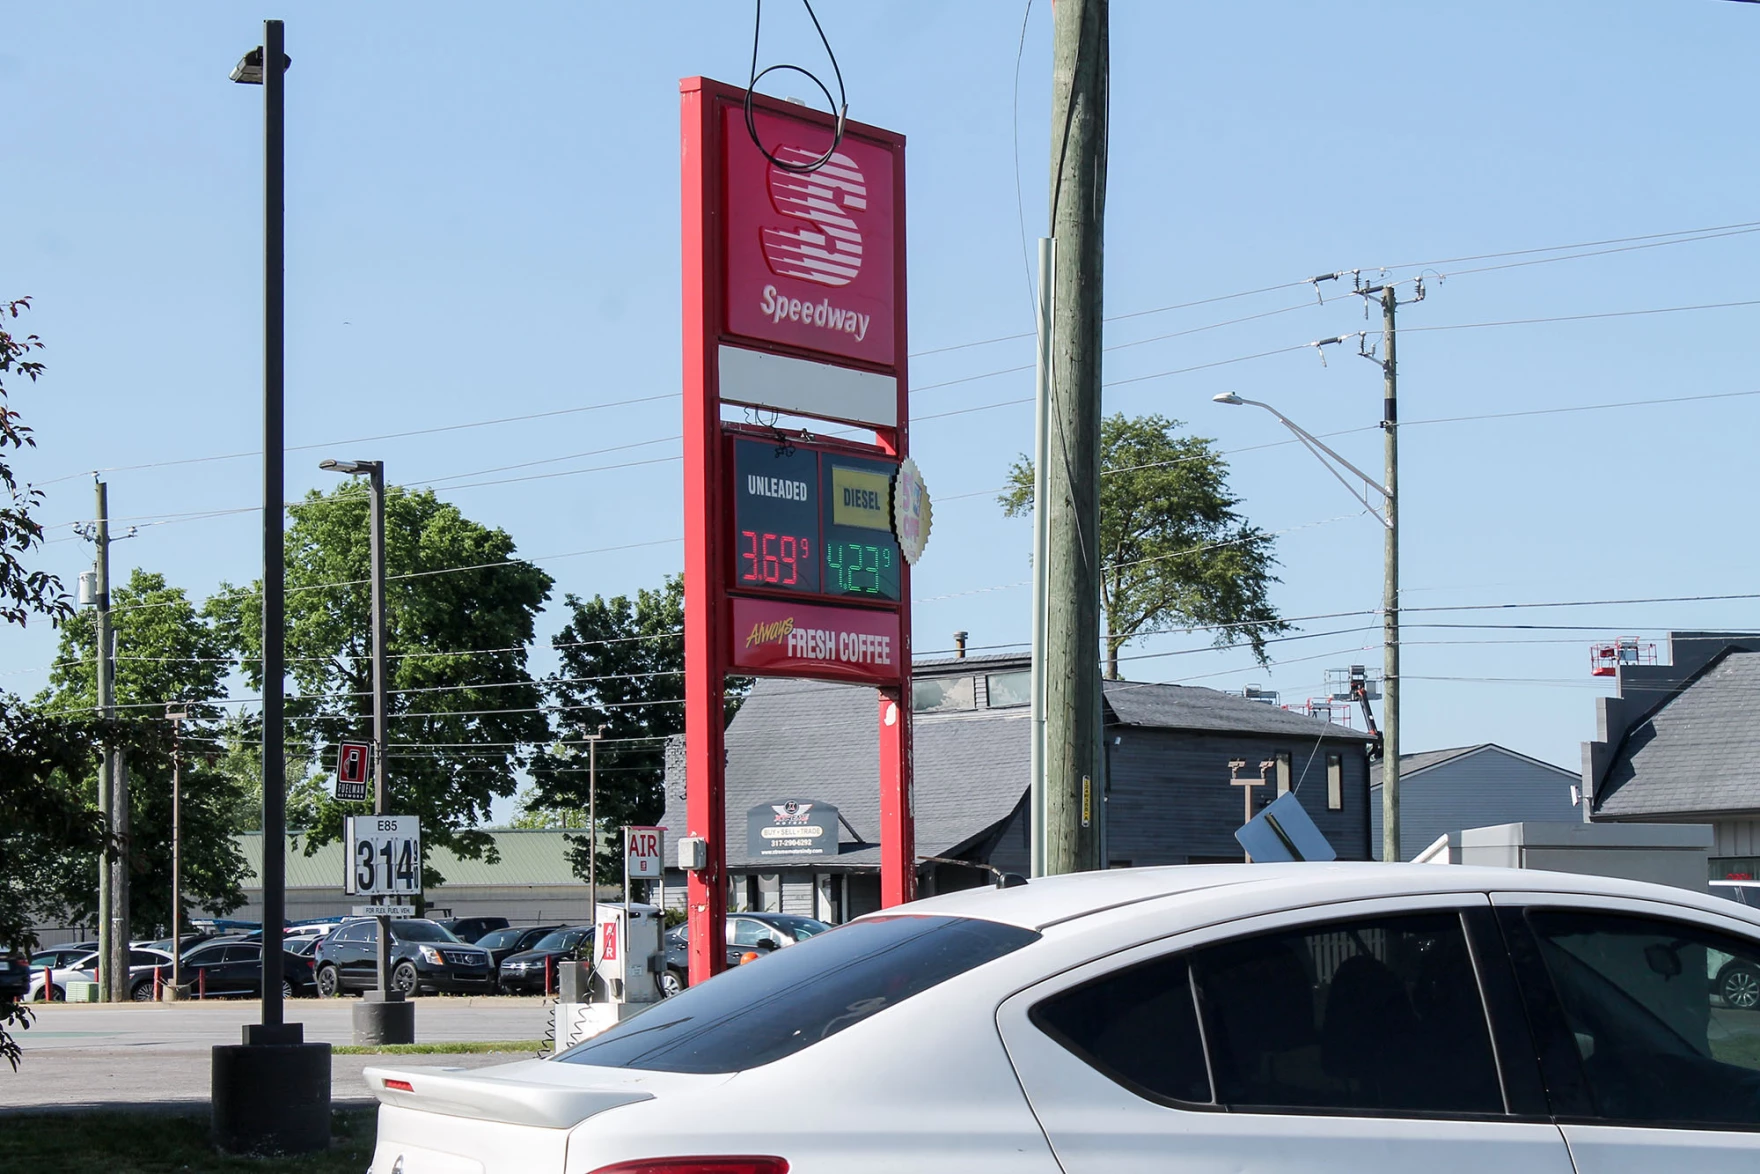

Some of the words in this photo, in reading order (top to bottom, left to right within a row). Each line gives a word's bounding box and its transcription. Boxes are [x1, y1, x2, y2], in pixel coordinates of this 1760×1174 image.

[760, 284, 870, 342] Speedway
[748, 474, 808, 501] UNLEADED
[843, 488, 881, 511] DIESEL
[746, 617, 794, 648] Always
[787, 628, 836, 661] FRESH
[839, 631, 891, 665] COFFEE
[338, 783, 365, 794] FUELMAN
[377, 820, 398, 832] E85
[780, 828, 796, 836] SELL
[799, 827, 821, 835] TRADE
[629, 834, 659, 857] AIR
[357, 839, 414, 891] 314
[605, 925, 614, 958] AIR
